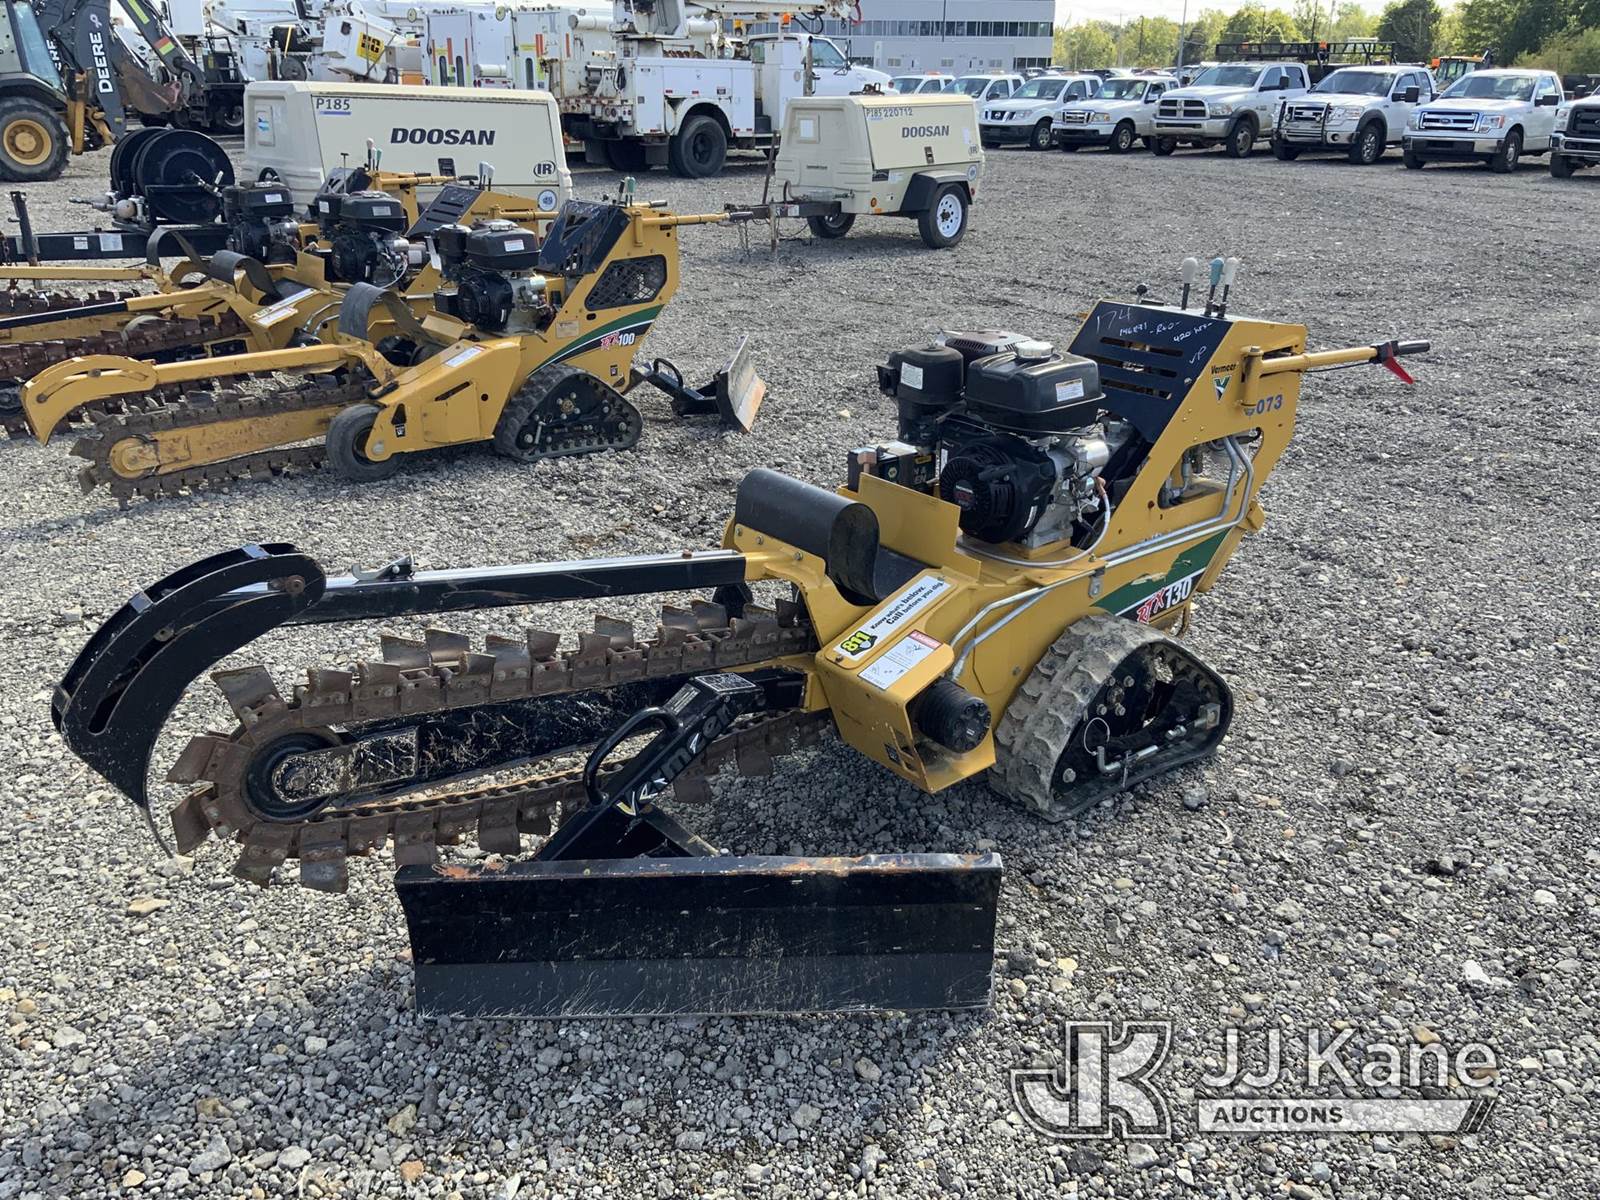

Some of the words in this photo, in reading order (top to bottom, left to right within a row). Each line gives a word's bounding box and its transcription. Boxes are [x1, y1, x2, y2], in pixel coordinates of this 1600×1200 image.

[89, 31, 114, 93] DEERE
[316, 97, 351, 111] P185
[390, 127, 496, 146] DOOSAN
[901, 125, 950, 138] DOOSAN
[1096, 307, 1131, 333] 174
[886, 611, 905, 626] Call
[841, 630, 872, 654] 811
